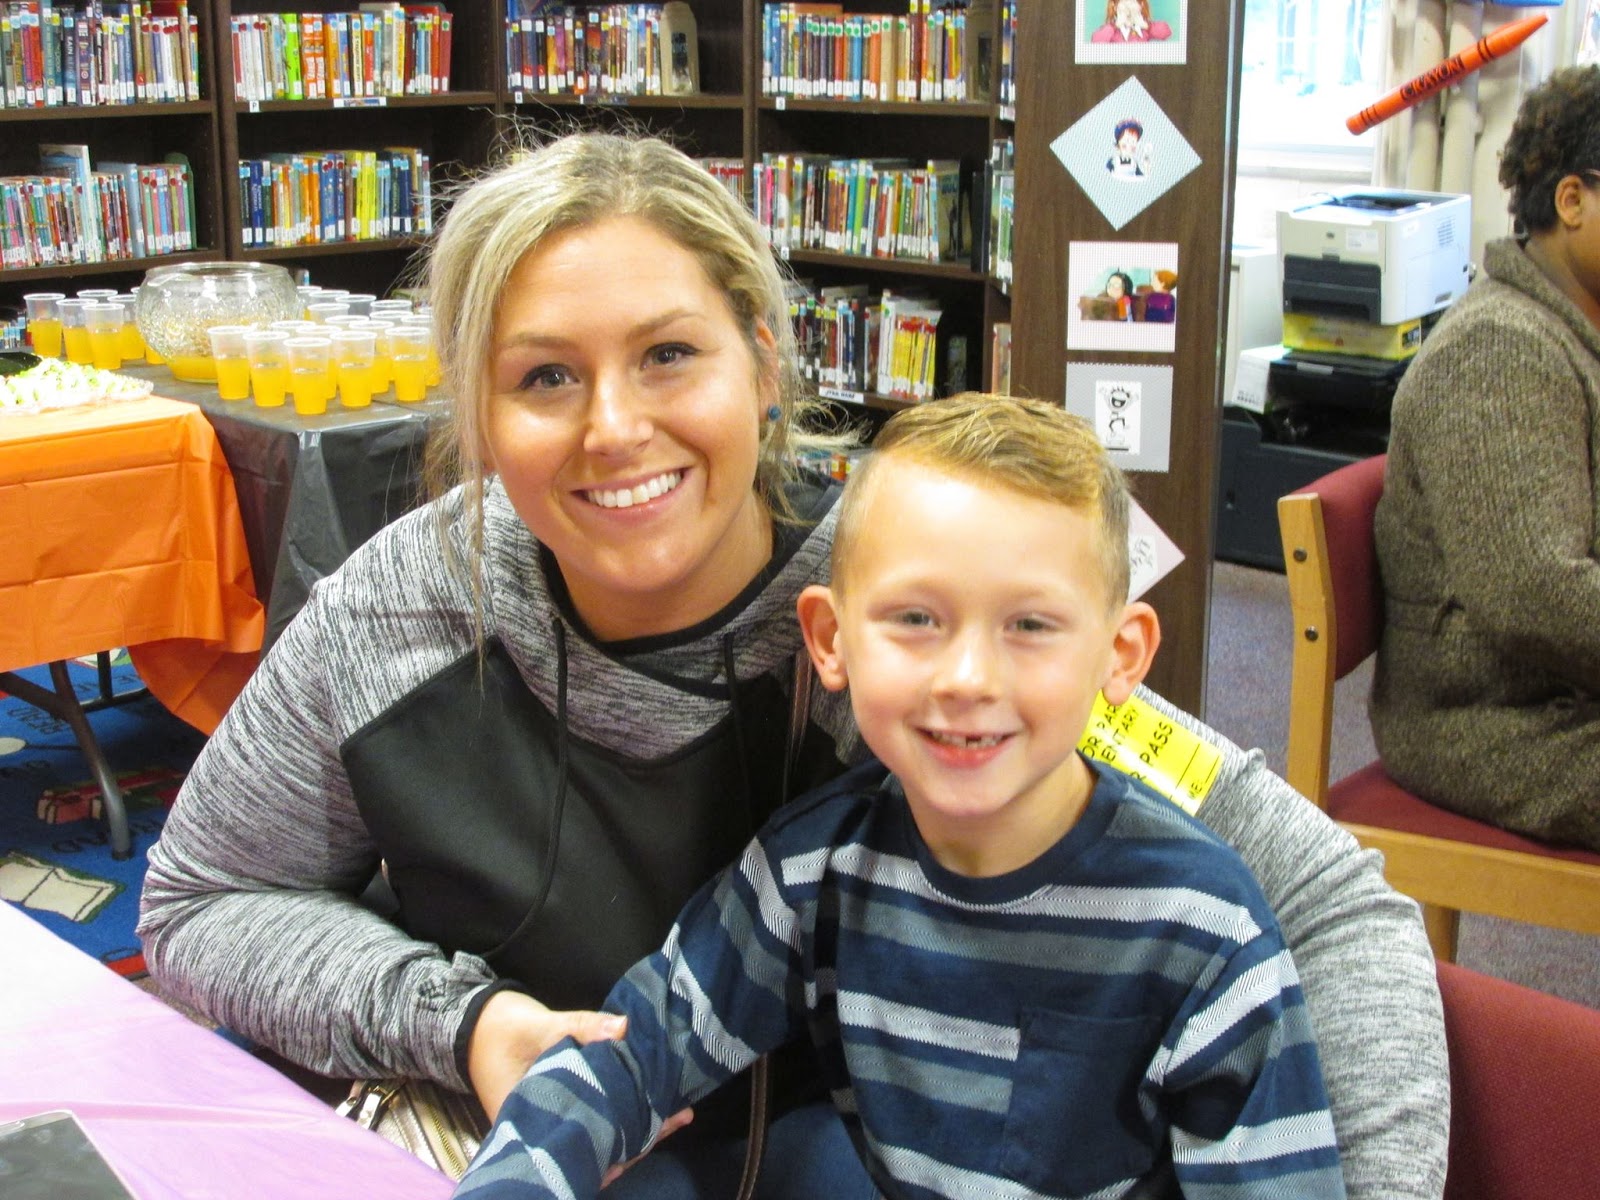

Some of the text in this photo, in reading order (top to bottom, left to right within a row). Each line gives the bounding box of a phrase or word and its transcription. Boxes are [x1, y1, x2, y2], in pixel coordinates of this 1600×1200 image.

[1399, 54, 1466, 101] CRAYON
[1082, 703, 1122, 759] OR PAR
[1101, 706, 1139, 761] ENTARY
[1139, 721, 1173, 767] PASS
